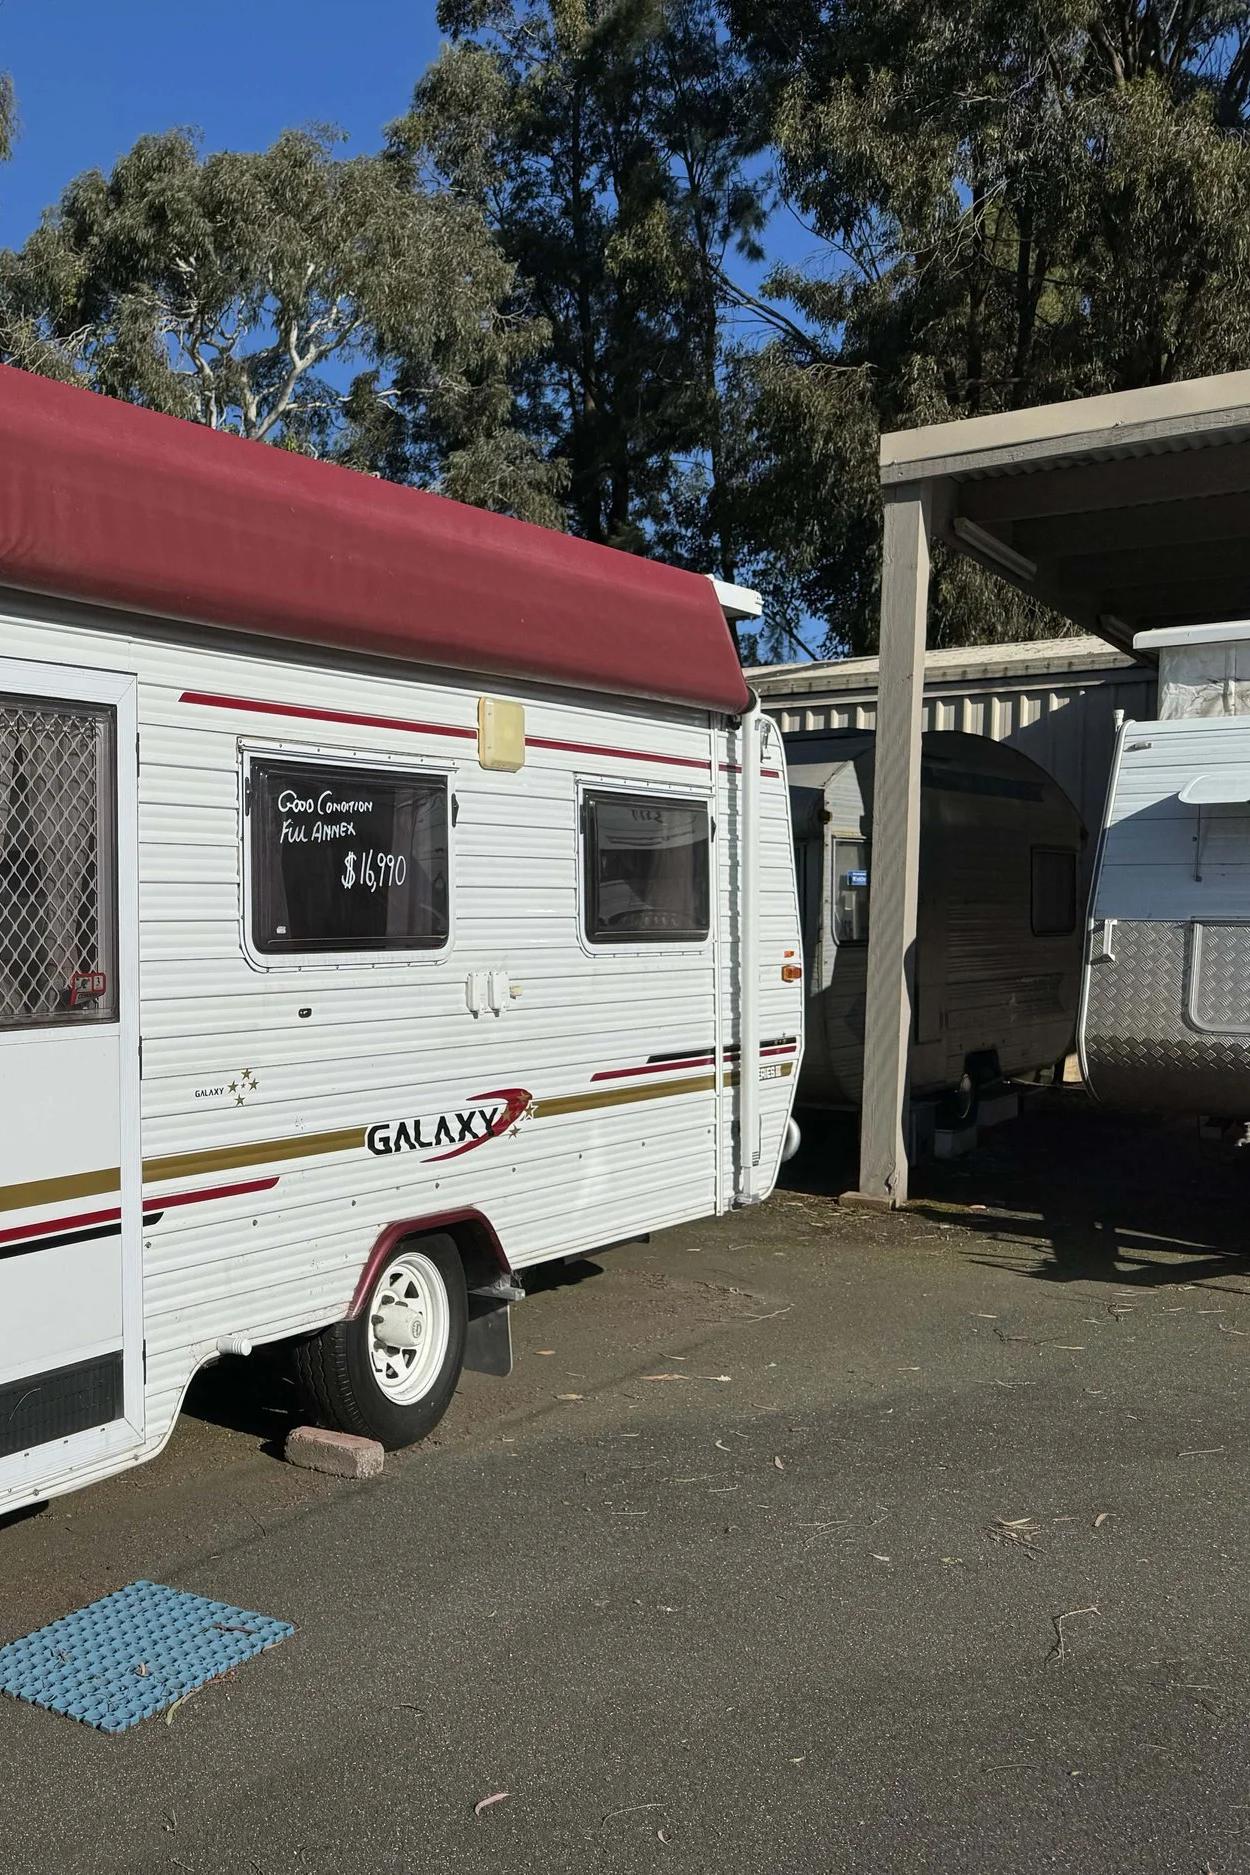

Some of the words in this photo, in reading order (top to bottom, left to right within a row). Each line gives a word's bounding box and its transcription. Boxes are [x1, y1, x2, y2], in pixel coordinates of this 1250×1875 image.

[278, 789, 314, 813] GOOD
[317, 790, 373, 815] CONDITION
[311, 821, 356, 843] ANNEX
[341, 848, 407, 893] $16,990
[194, 1087, 225, 1098] GALAXY
[366, 1106, 499, 1156] GALAXY
